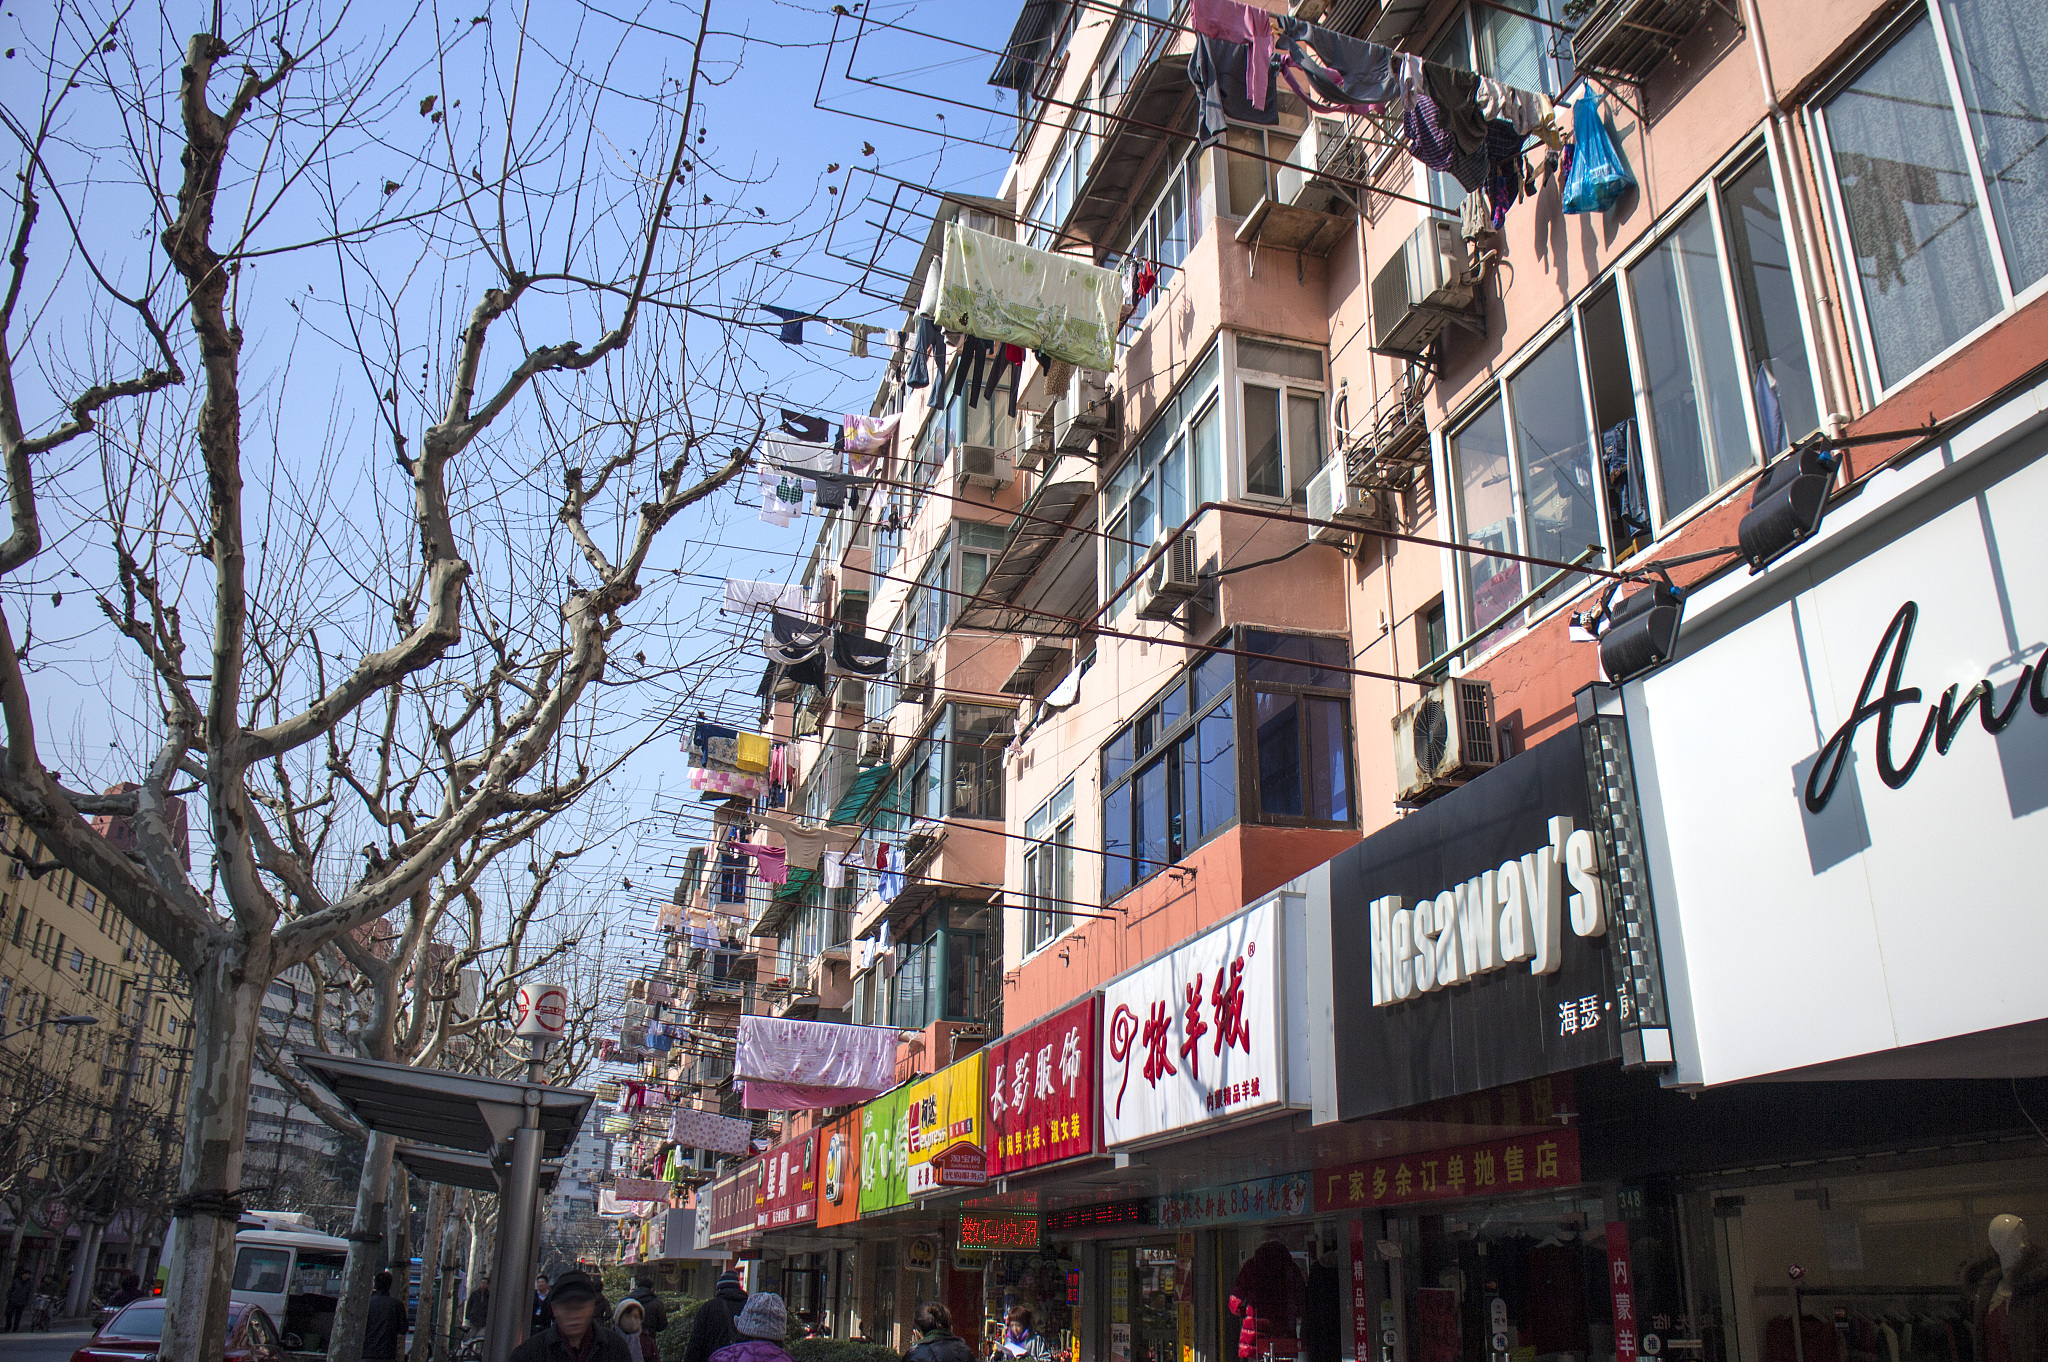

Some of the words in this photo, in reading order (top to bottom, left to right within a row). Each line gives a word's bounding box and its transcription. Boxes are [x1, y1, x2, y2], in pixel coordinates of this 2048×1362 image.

[1370, 815, 1611, 1007] Hesaway's
[1143, 955, 1250, 1089] 牧羊绒
[991, 1026, 1081, 1122] 长影服饰
[1206, 1076, 1260, 1112] 内蒙精品羊绒
[919, 1127, 947, 1151] express
[951, 1154, 981, 1165] 淘宝网
[1327, 1140, 1558, 1203] 厂家多余订单抛售店
[945, 1171, 985, 1181] 代购服务点
[1618, 1190, 1641, 1209] 348
[962, 1216, 1037, 1245] 数码快照
[1353, 1259, 1367, 1362] 精品羊绒
[1647, 1338, 1659, 1350] 推
